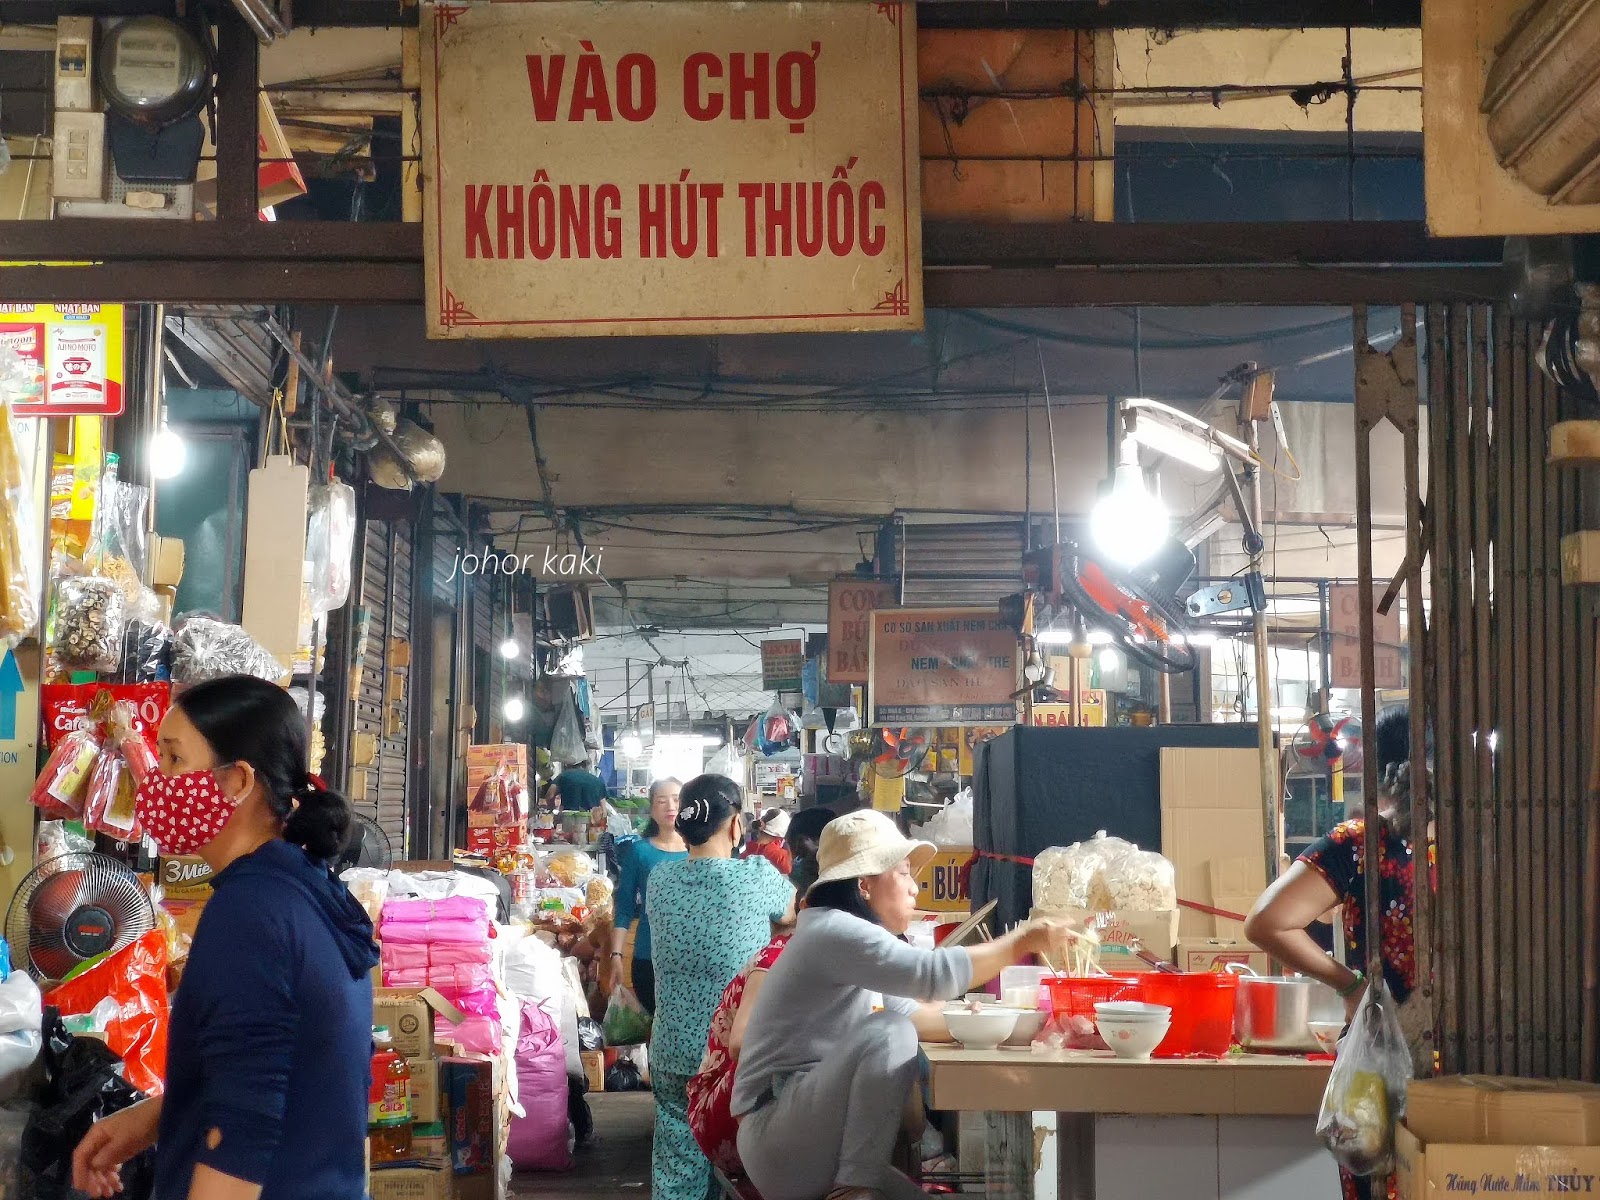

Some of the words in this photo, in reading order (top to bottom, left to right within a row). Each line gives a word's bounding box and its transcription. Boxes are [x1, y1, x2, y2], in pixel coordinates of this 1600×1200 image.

[525, 40, 657, 122] VÀO
[683, 40, 820, 134] CHỢ
[464, 168, 622, 260] KHÔNG
[638, 168, 724, 258] HÚT
[738, 156, 886, 258] THUỐC
[842, 615, 870, 641] BÚ
[911, 657, 939, 670] NEM
[1047, 710, 1089, 727] BÁ
